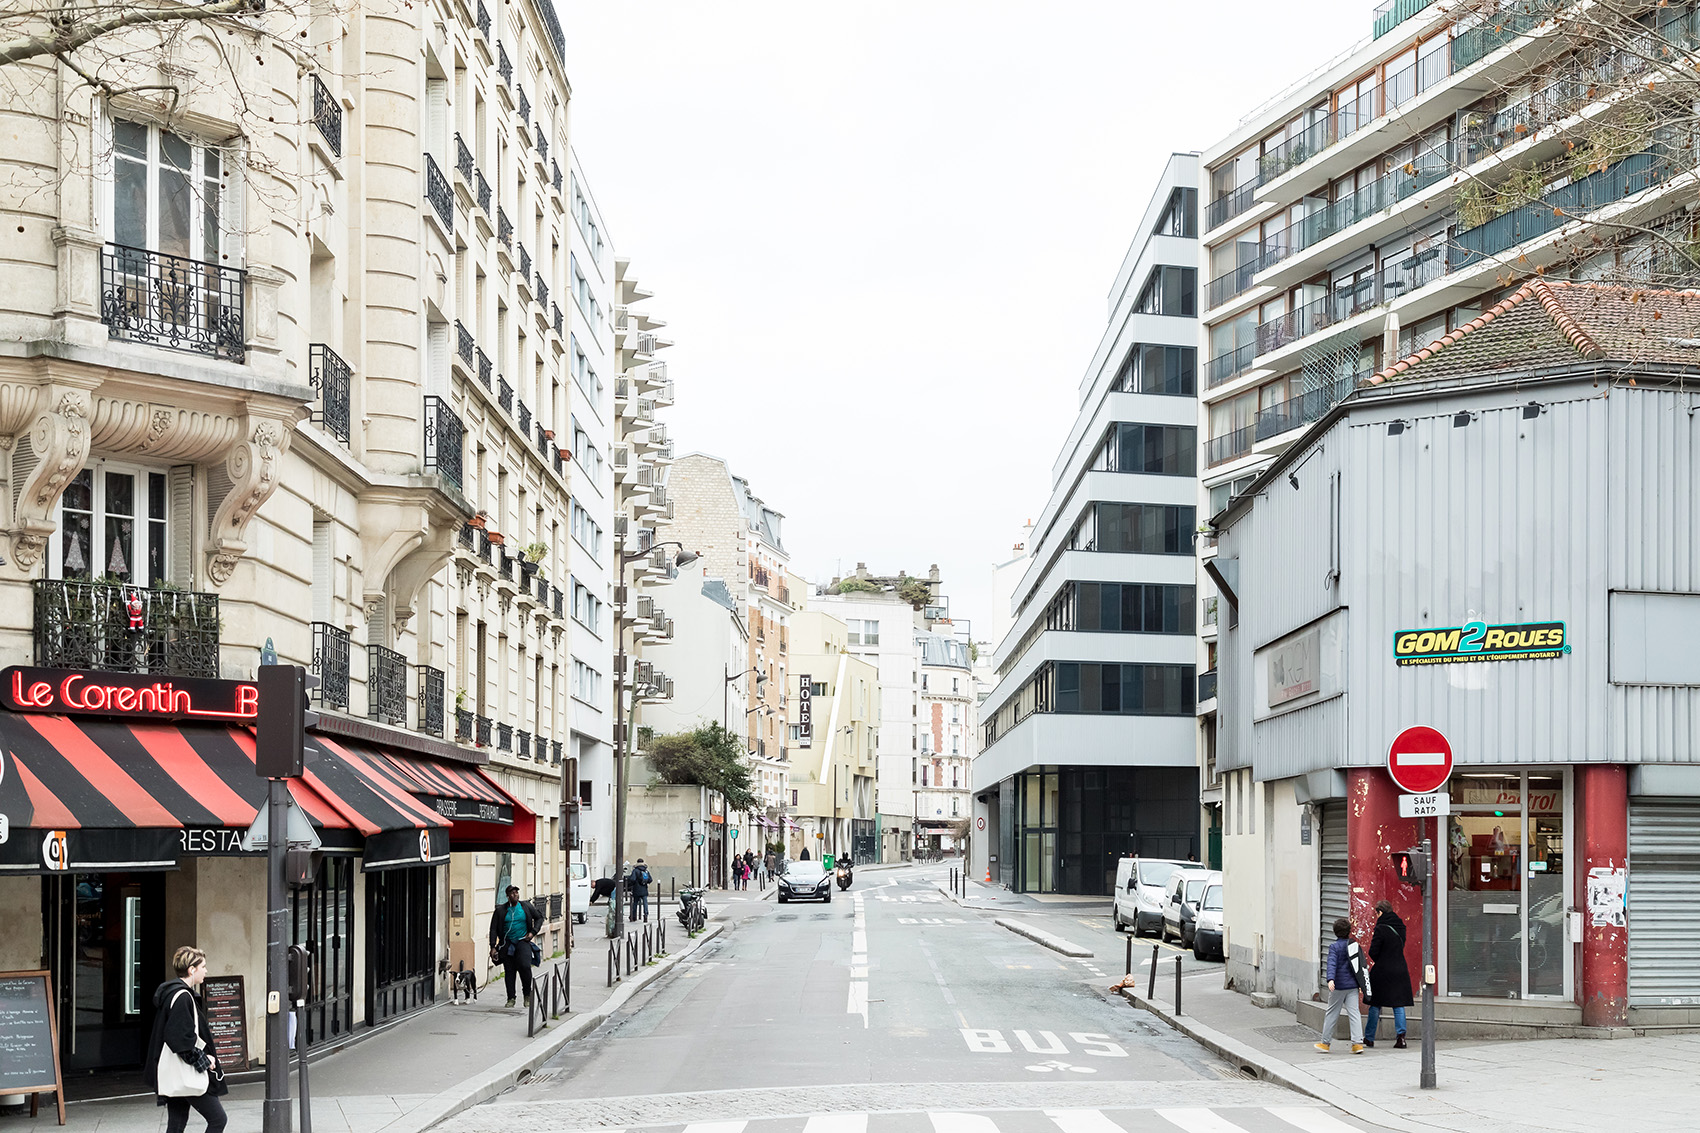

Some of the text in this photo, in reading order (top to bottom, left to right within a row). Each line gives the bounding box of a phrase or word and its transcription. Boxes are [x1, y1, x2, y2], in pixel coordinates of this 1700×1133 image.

[1409, 657, 1442, 665] SPÉCIALISTE
[13, 670, 54, 707] Le
[60, 673, 191, 713] Corentin
[800, 677, 810, 735] HOTEL
[1413, 796, 1437, 805] SAUF
[1414, 806, 1437, 815] RATP
[179, 829, 247, 851] RESTA
[959, 1029, 1130, 1058] BUS
